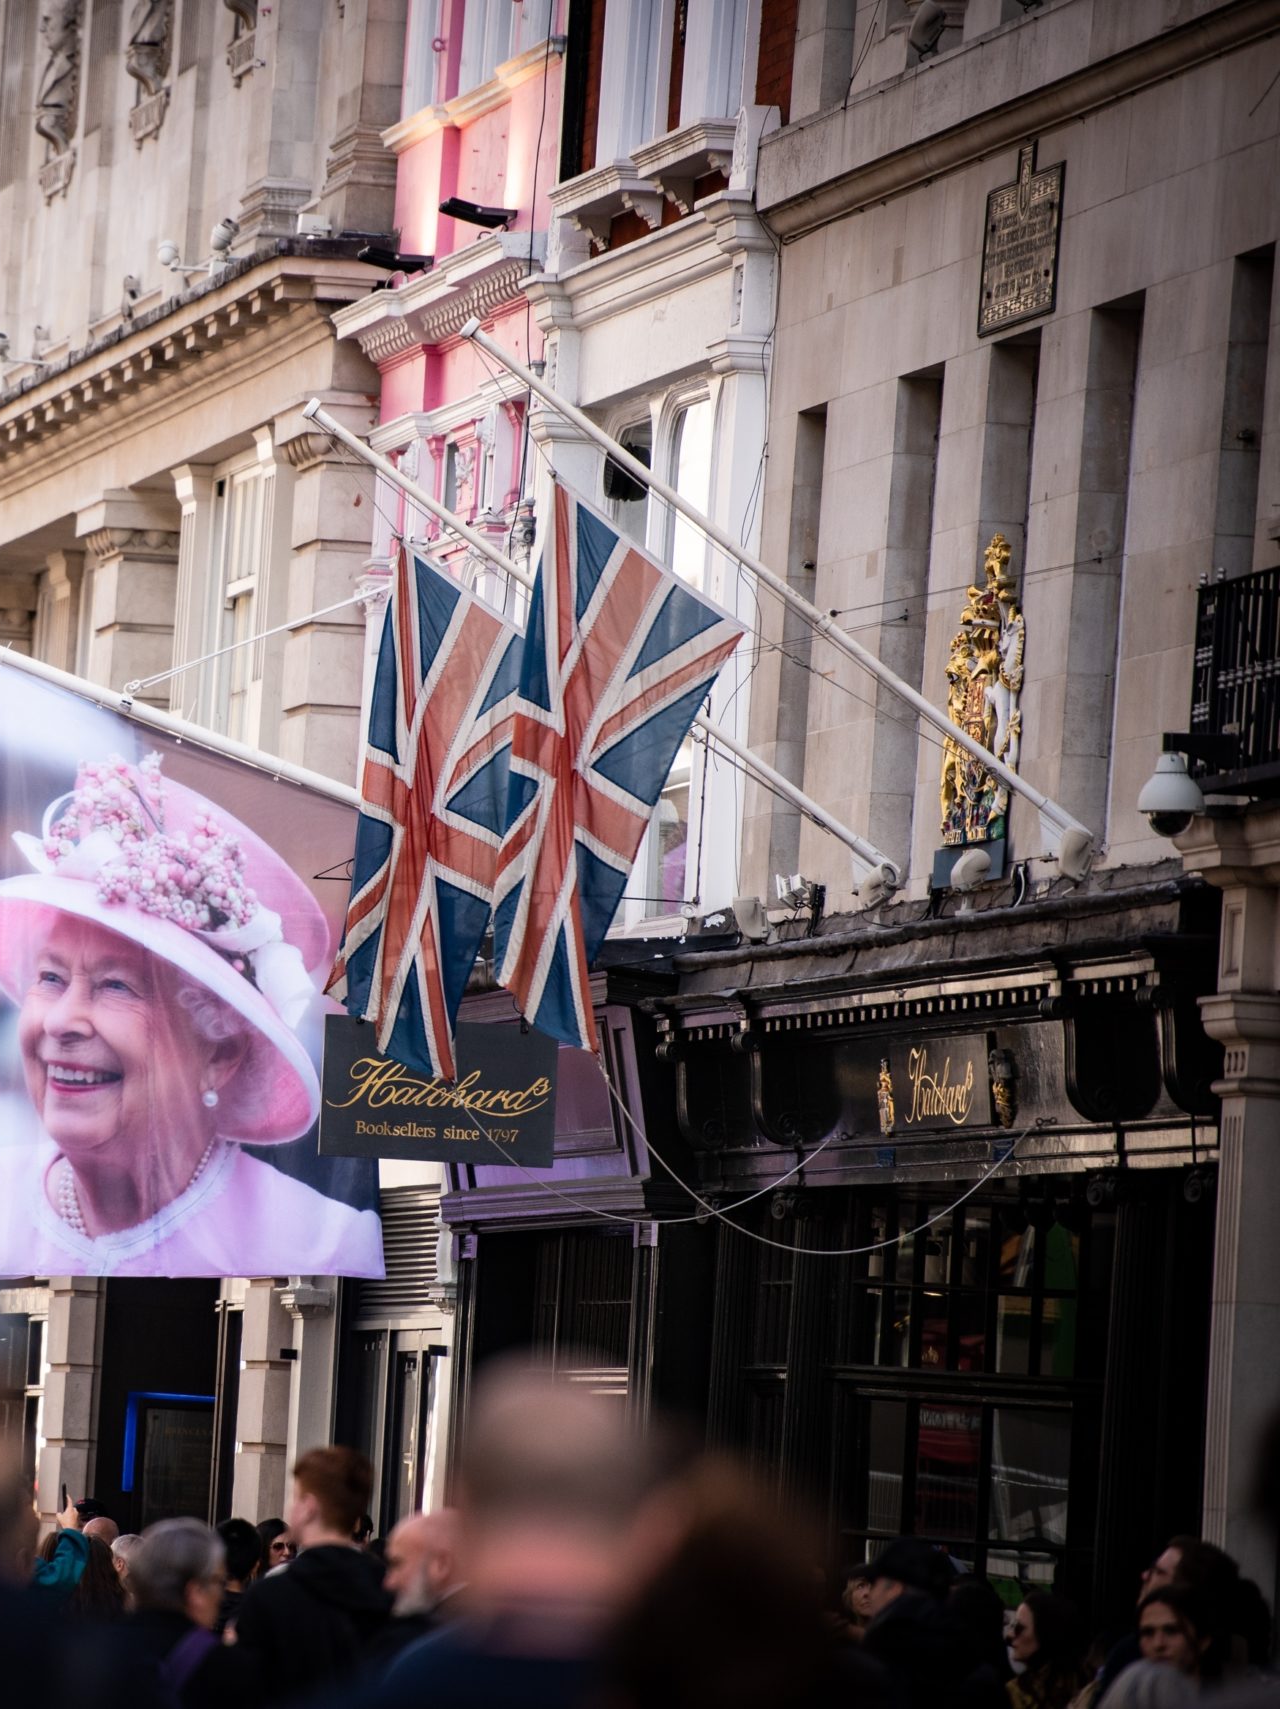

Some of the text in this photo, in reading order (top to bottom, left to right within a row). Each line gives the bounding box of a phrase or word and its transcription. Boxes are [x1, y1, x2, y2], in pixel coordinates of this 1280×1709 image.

[326, 1057, 552, 1117] Hatchards
[355, 1120, 519, 1143] Booksellers since 1797
